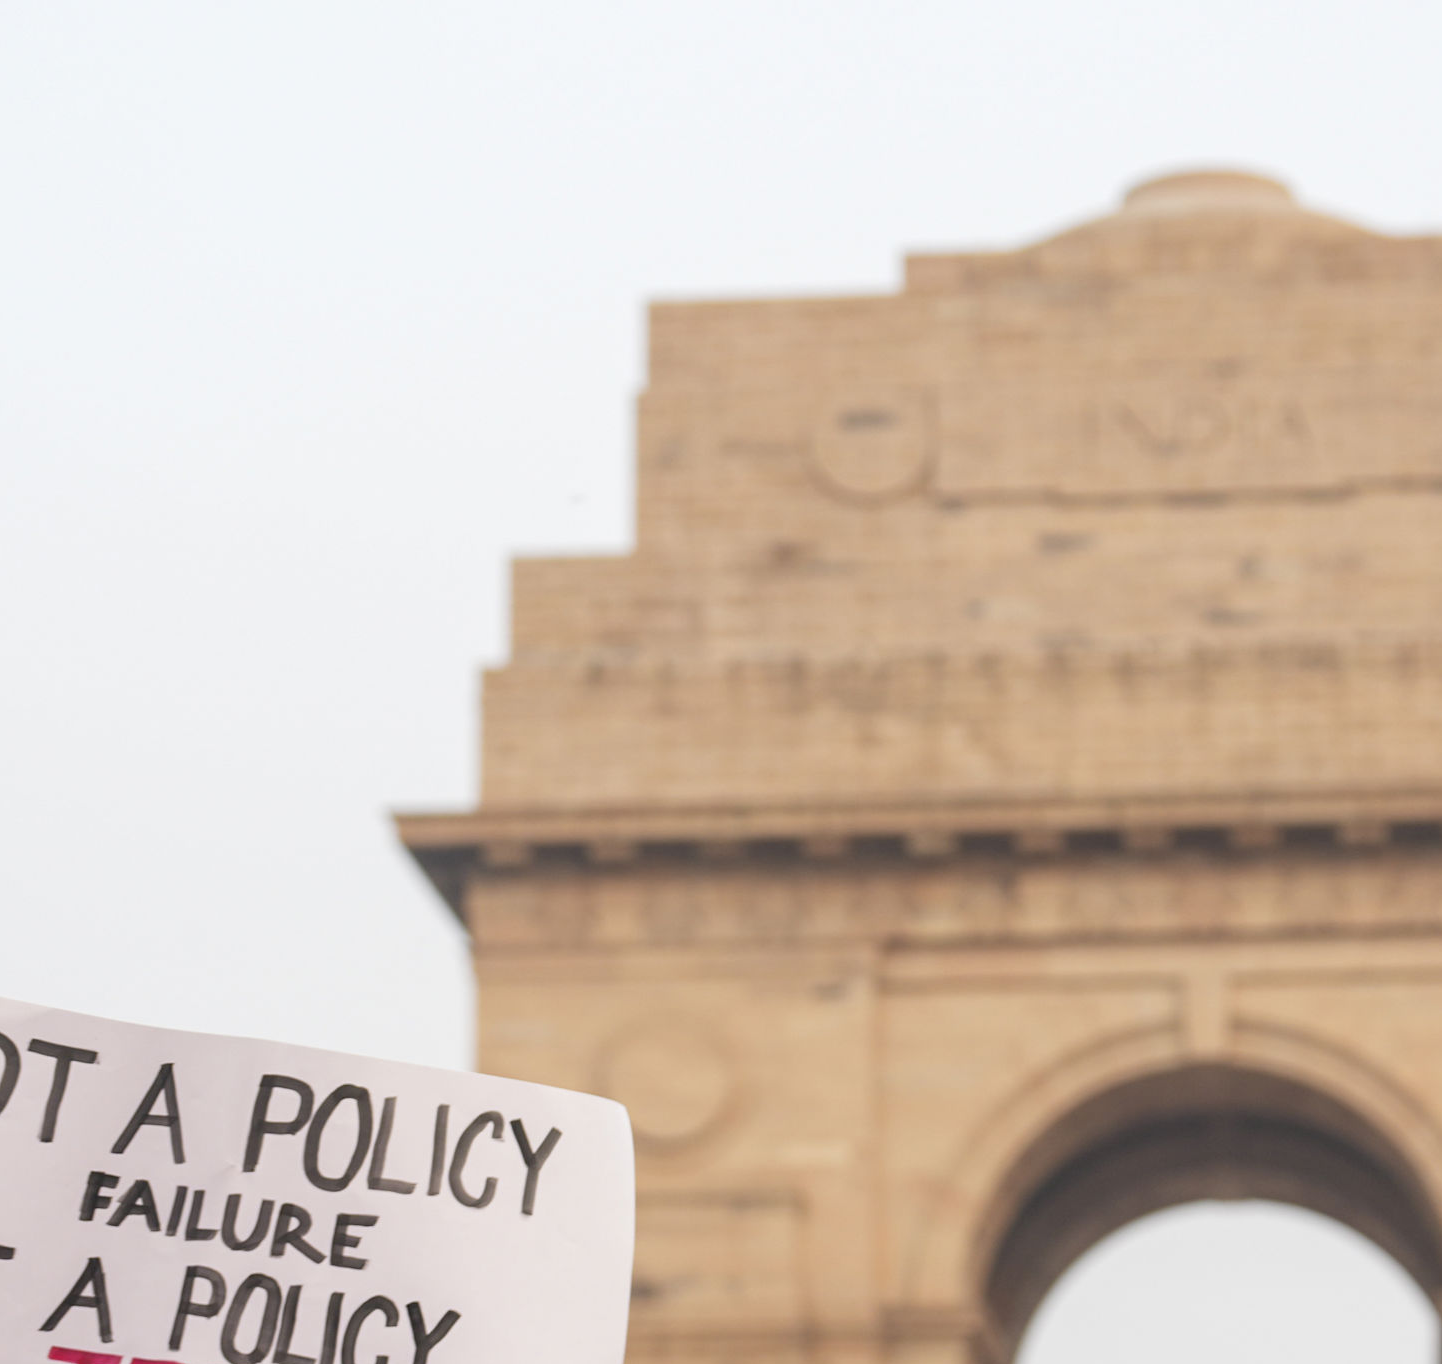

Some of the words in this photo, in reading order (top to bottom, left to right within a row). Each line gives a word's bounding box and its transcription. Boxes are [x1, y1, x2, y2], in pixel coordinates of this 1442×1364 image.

[111, 1062, 185, 1163] A
[243, 1073, 562, 1216] POLICY
[79, 1171, 379, 1270] FAILURE
[39, 1257, 113, 1342] A
